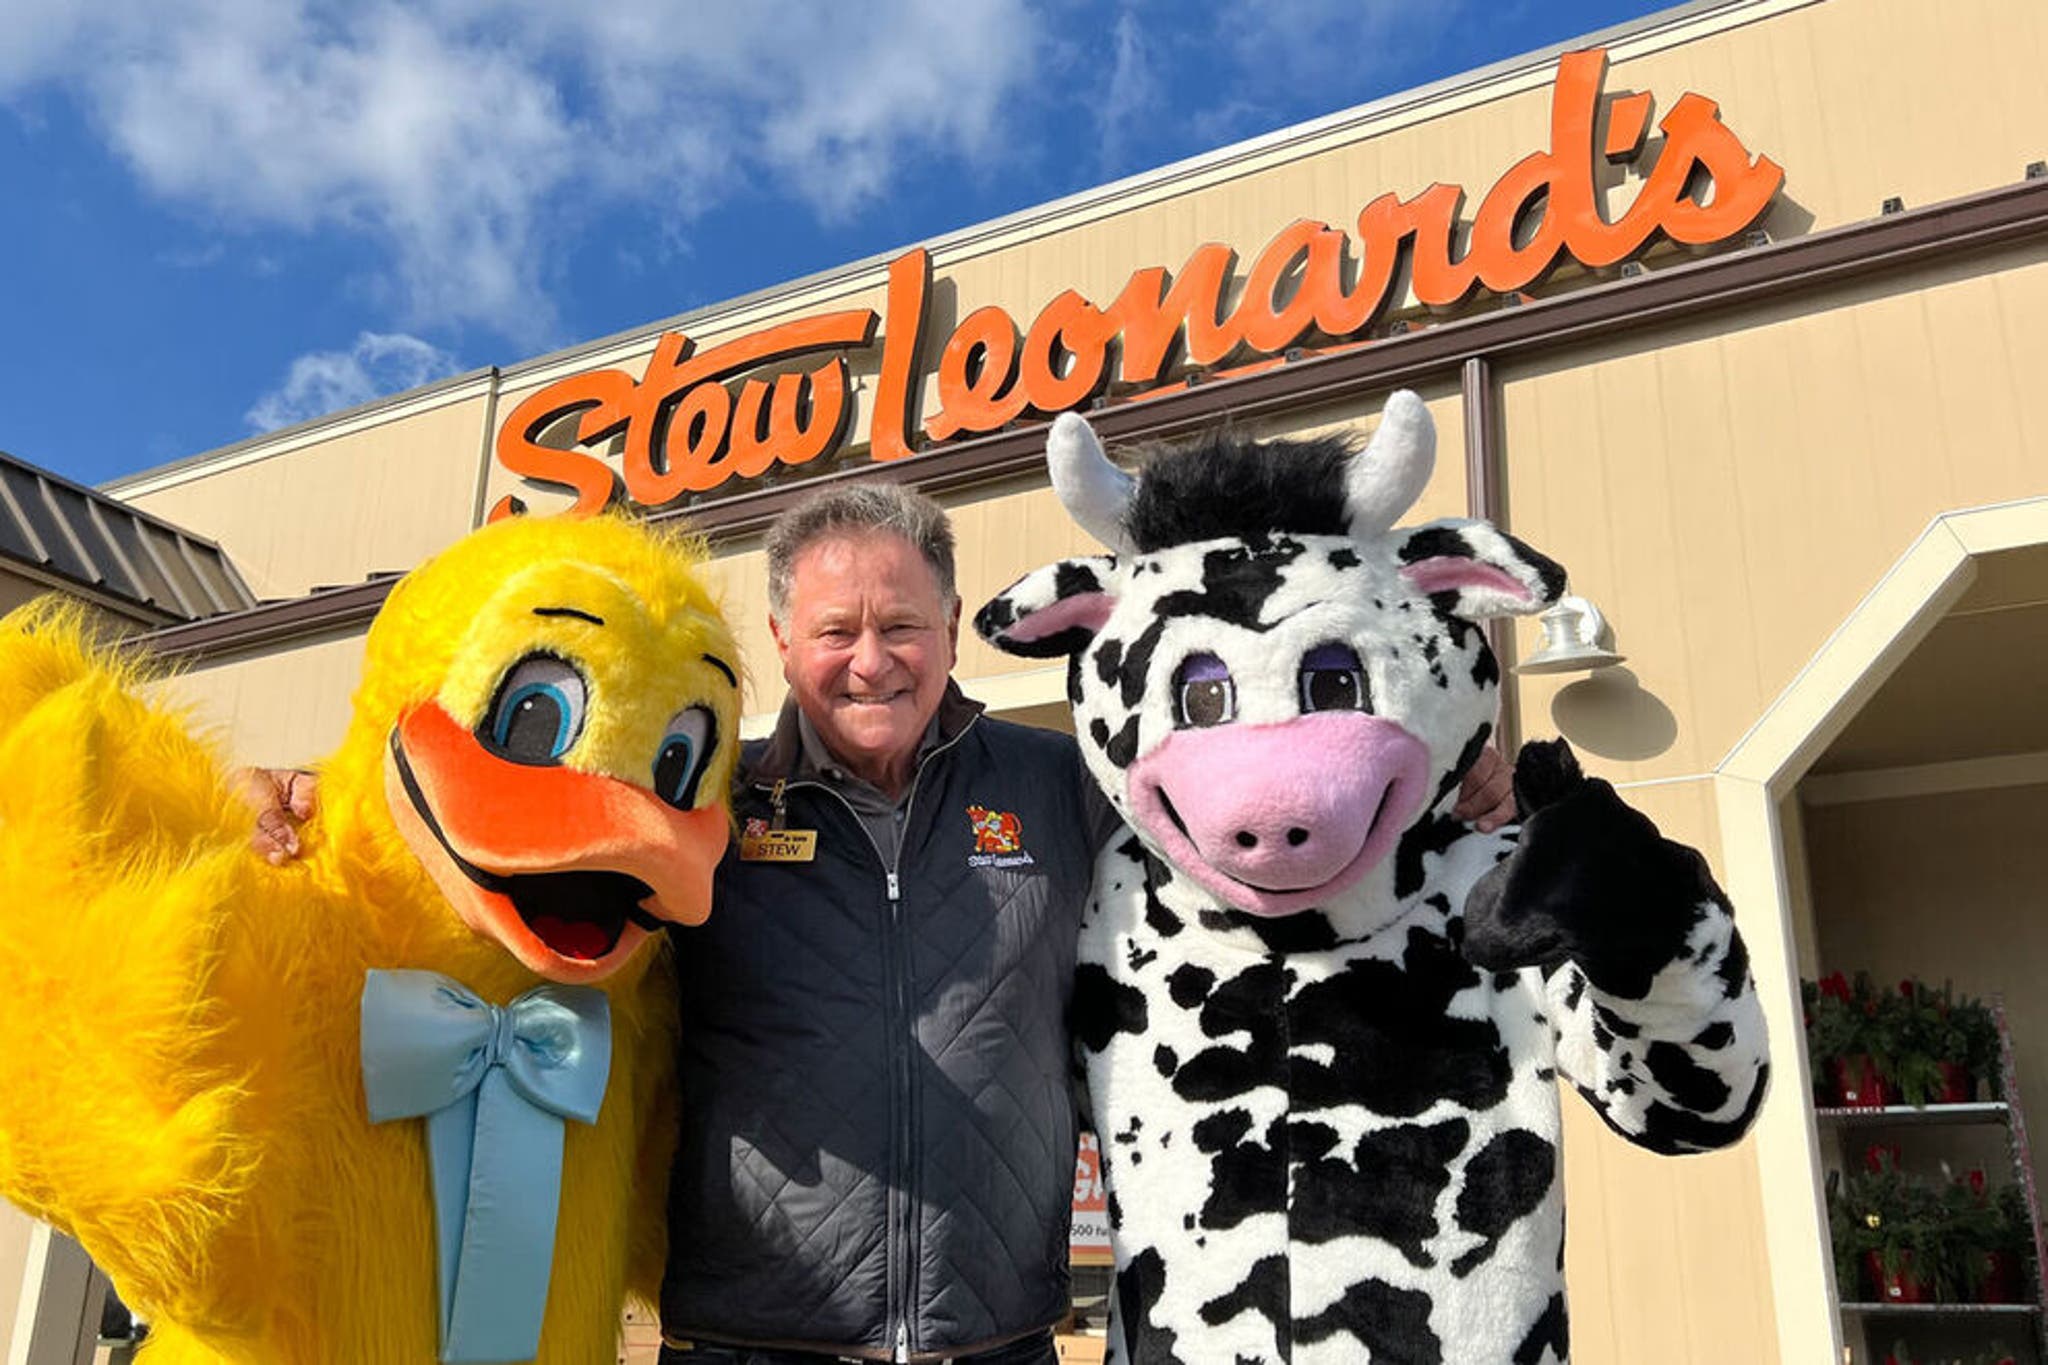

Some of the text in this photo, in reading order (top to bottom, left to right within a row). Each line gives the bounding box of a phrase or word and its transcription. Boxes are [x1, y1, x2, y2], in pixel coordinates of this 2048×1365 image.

[487, 48, 1785, 523] Stew Leonard's
[758, 843, 801, 856] STEW
